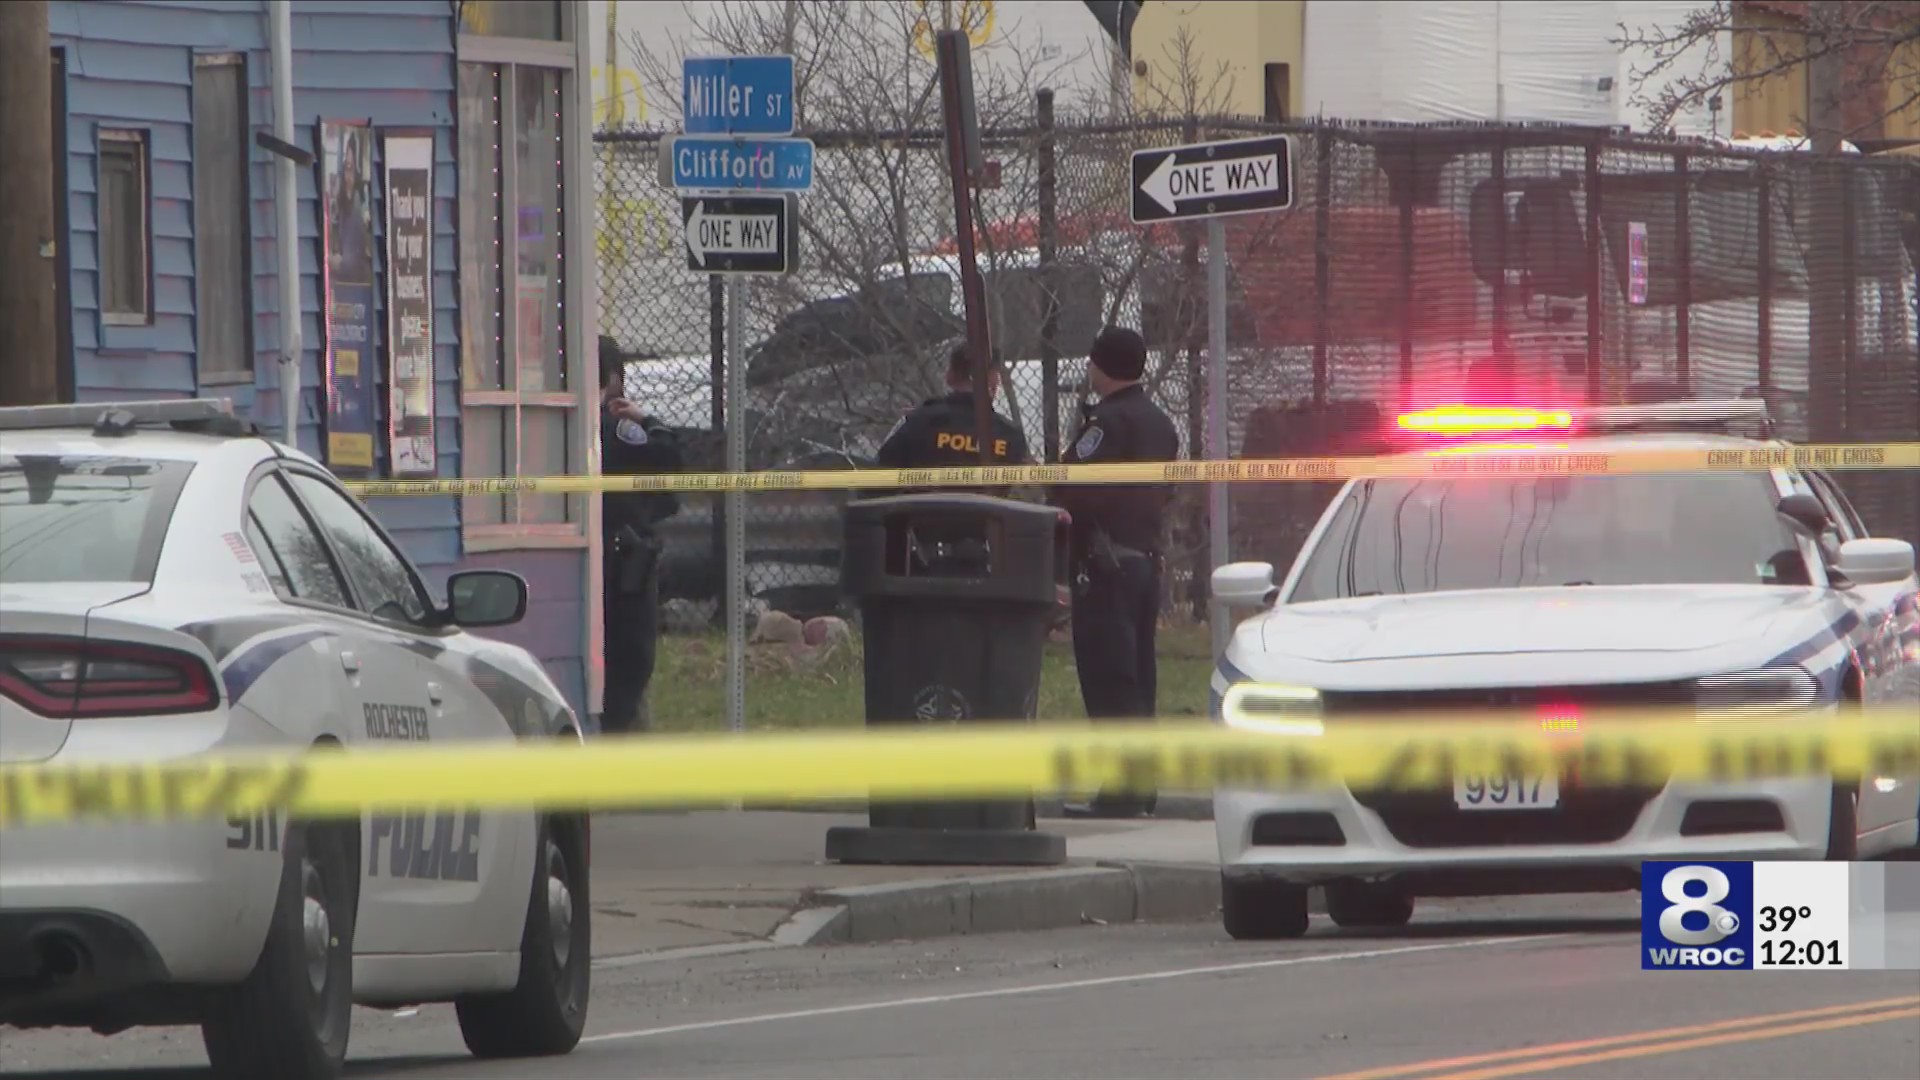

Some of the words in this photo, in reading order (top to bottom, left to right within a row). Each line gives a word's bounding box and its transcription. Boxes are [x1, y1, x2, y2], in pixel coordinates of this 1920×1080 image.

[690, 75, 753, 118] Miller
[766, 94, 783, 117] ST
[679, 148, 775, 179] Clifford
[787, 165, 805, 179] AV
[1169, 166, 1215, 196] ONE
[1225, 159, 1272, 190] WAY
[392, 187, 413, 219] Thank
[412, 195, 425, 226] you
[699, 219, 734, 248] ONE
[740, 219, 774, 248] WAY
[1707, 450, 1744, 465] CRIME
[1750, 449, 1788, 465] SCENE
[1794, 448, 1811, 464] DO
[1815, 448, 1840, 464] NOT
[1843, 447, 1886, 464] CROSS
[362, 701, 430, 742] ROCHESTER
